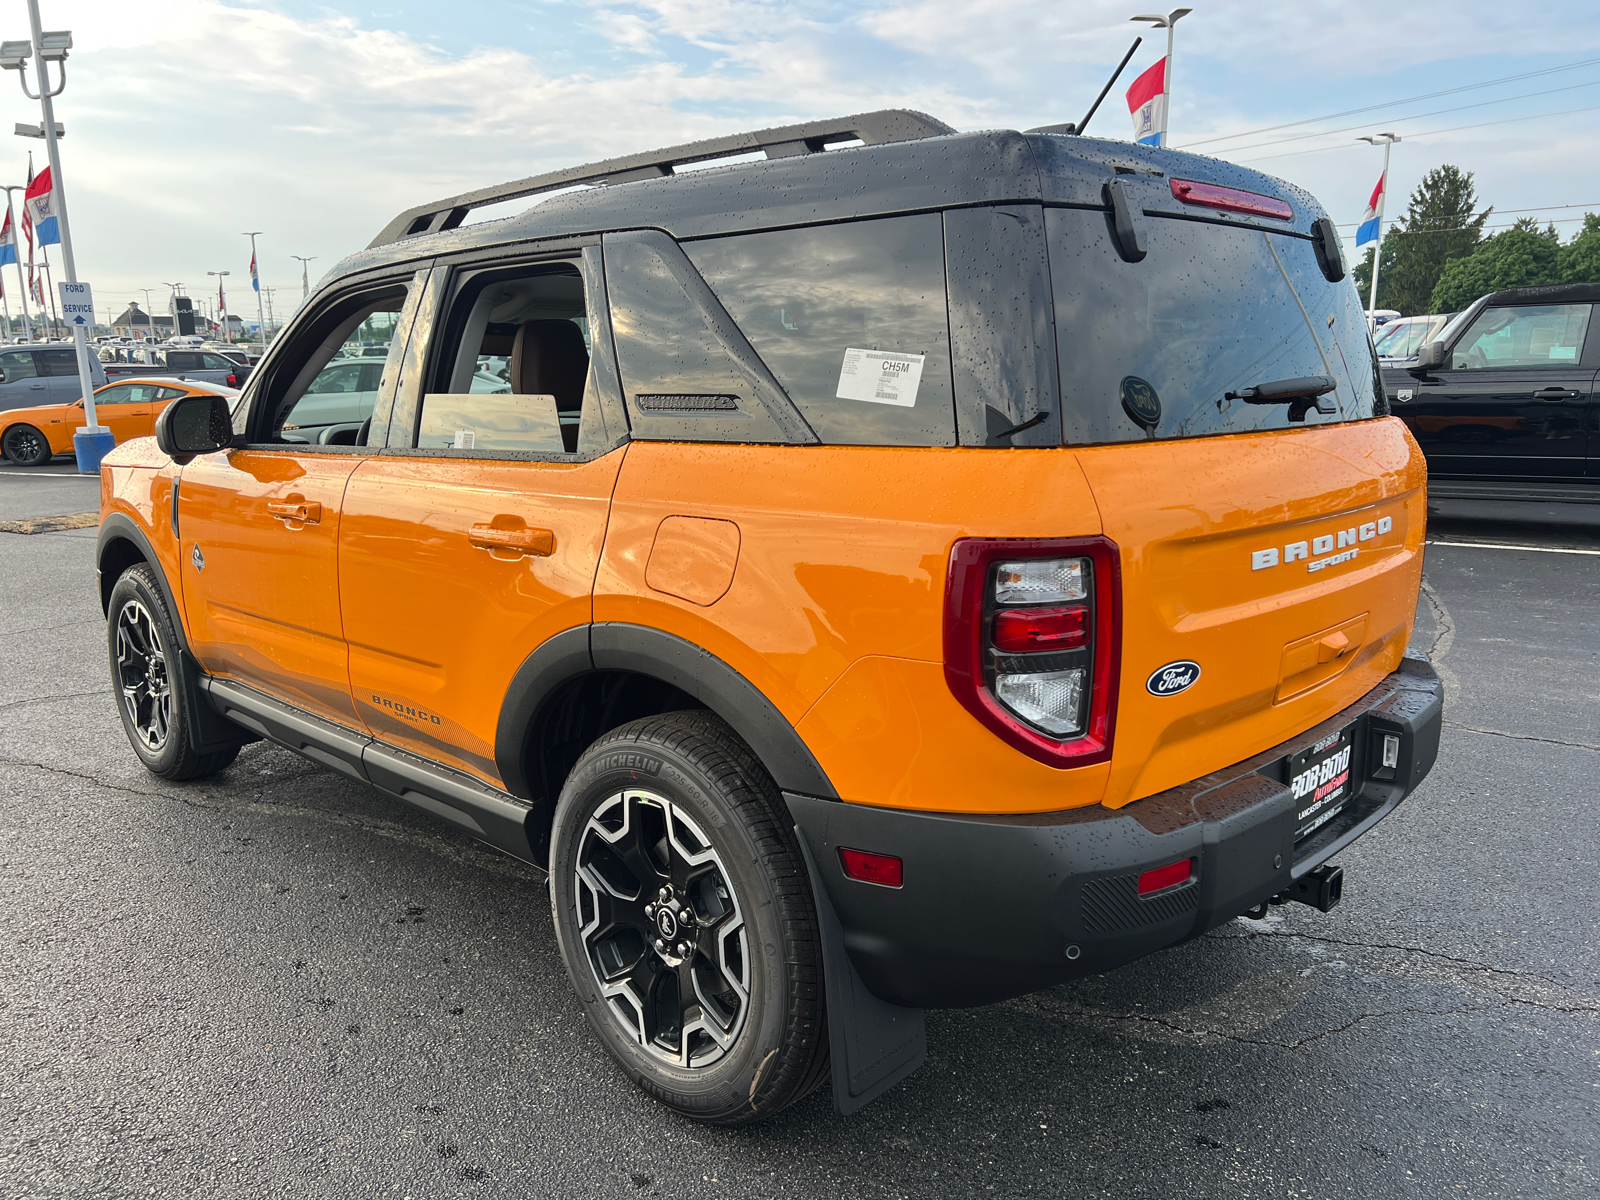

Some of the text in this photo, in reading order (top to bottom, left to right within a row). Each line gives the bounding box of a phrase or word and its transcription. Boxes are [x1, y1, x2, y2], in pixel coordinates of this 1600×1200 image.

[65, 284, 85, 293] FORD
[63, 304, 92, 313] SERVICE
[881, 360, 910, 373] CH5M
[1251, 515, 1392, 571] BRONCO
[1307, 547, 1360, 573] SPORT
[1158, 666, 1193, 691] Ford
[371, 694, 441, 725] BRONCO
[595, 754, 660, 775] MICHELIN
[669, 770, 701, 800] 225/60
[700, 799, 710, 809] R
[709, 810, 720, 823] 18
[641, 1079, 708, 1107] MICHELIN
